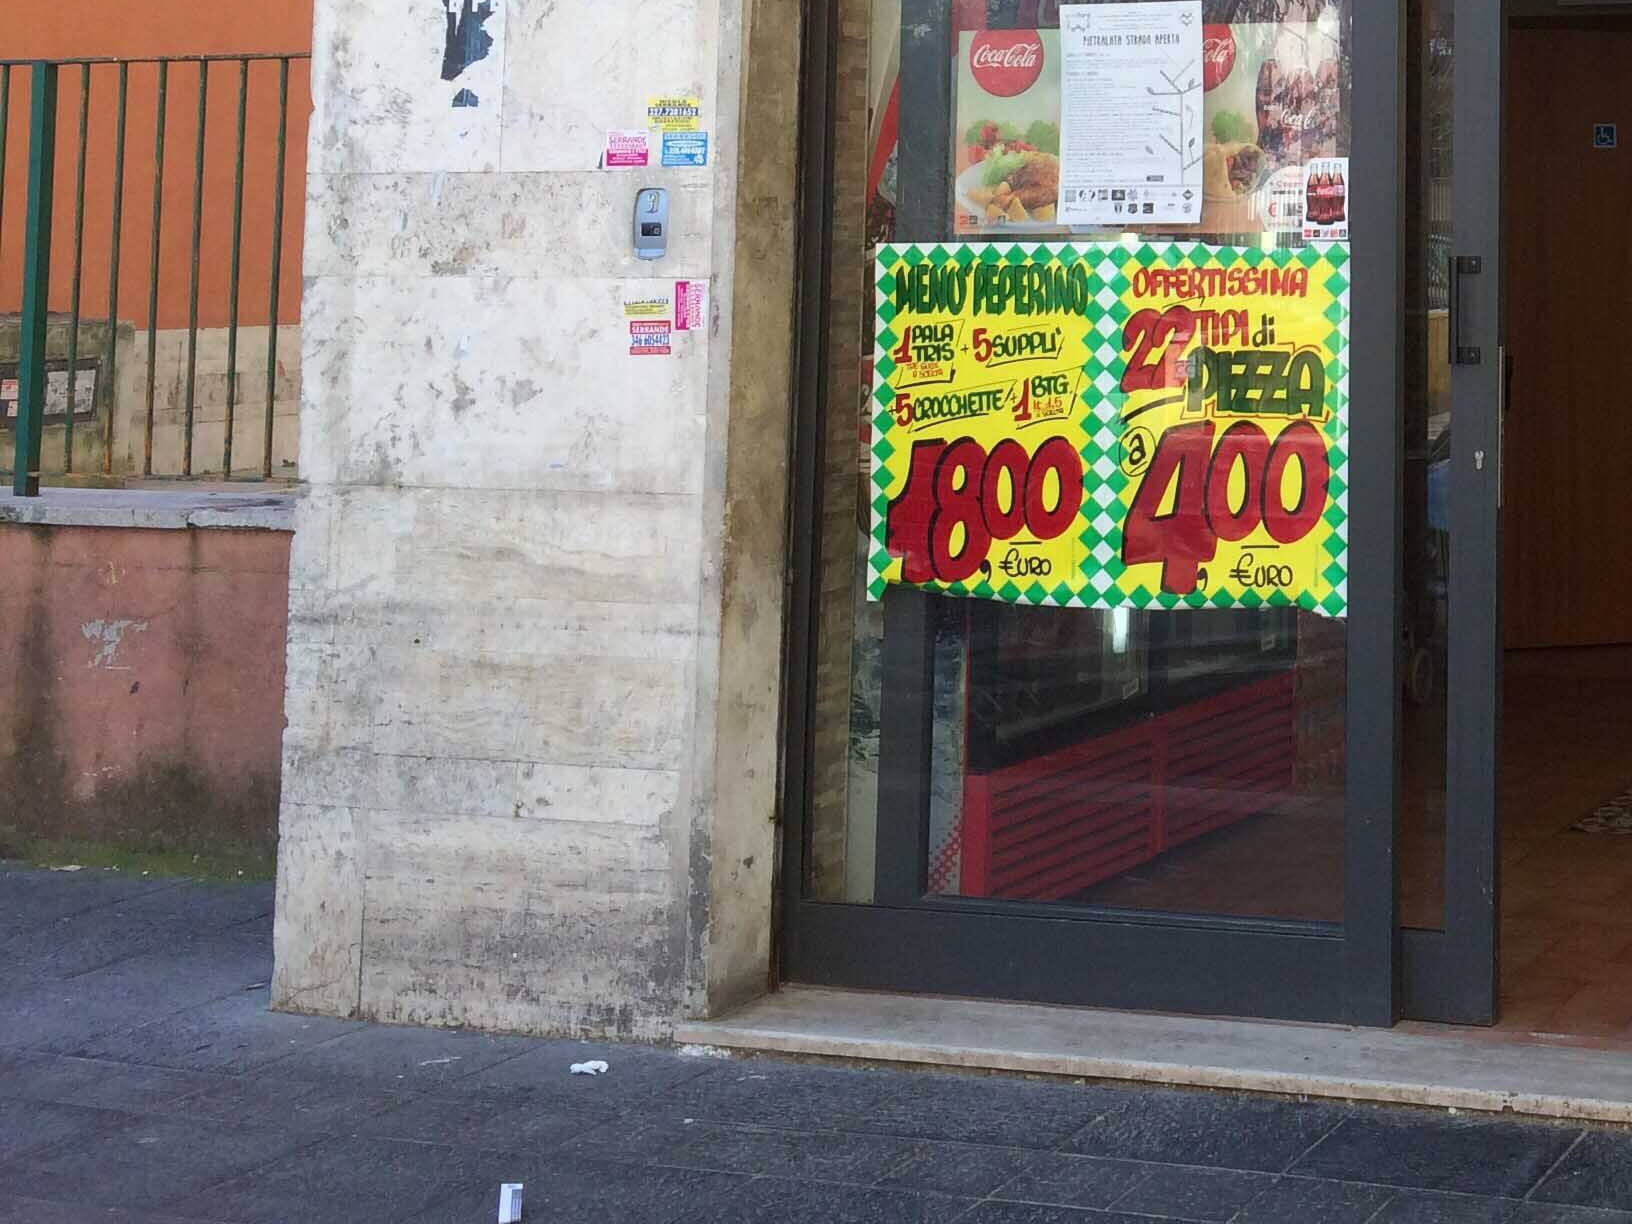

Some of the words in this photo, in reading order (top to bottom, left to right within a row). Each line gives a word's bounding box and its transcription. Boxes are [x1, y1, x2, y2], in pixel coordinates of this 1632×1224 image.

[973, 261, 1089, 317] PEPERINO
[1132, 267, 1309, 298] OFFERTISSIMA
[911, 323, 955, 344] PALA
[972, 327, 993, 363] 5
[1120, 304, 1196, 394] 22
[1192, 308, 1250, 347] TIPI
[1252, 313, 1276, 348] di
[911, 344, 956, 362] TRIS
[1186, 345, 1326, 417] PIZZA
[912, 388, 1005, 422] CROCCHETTE
